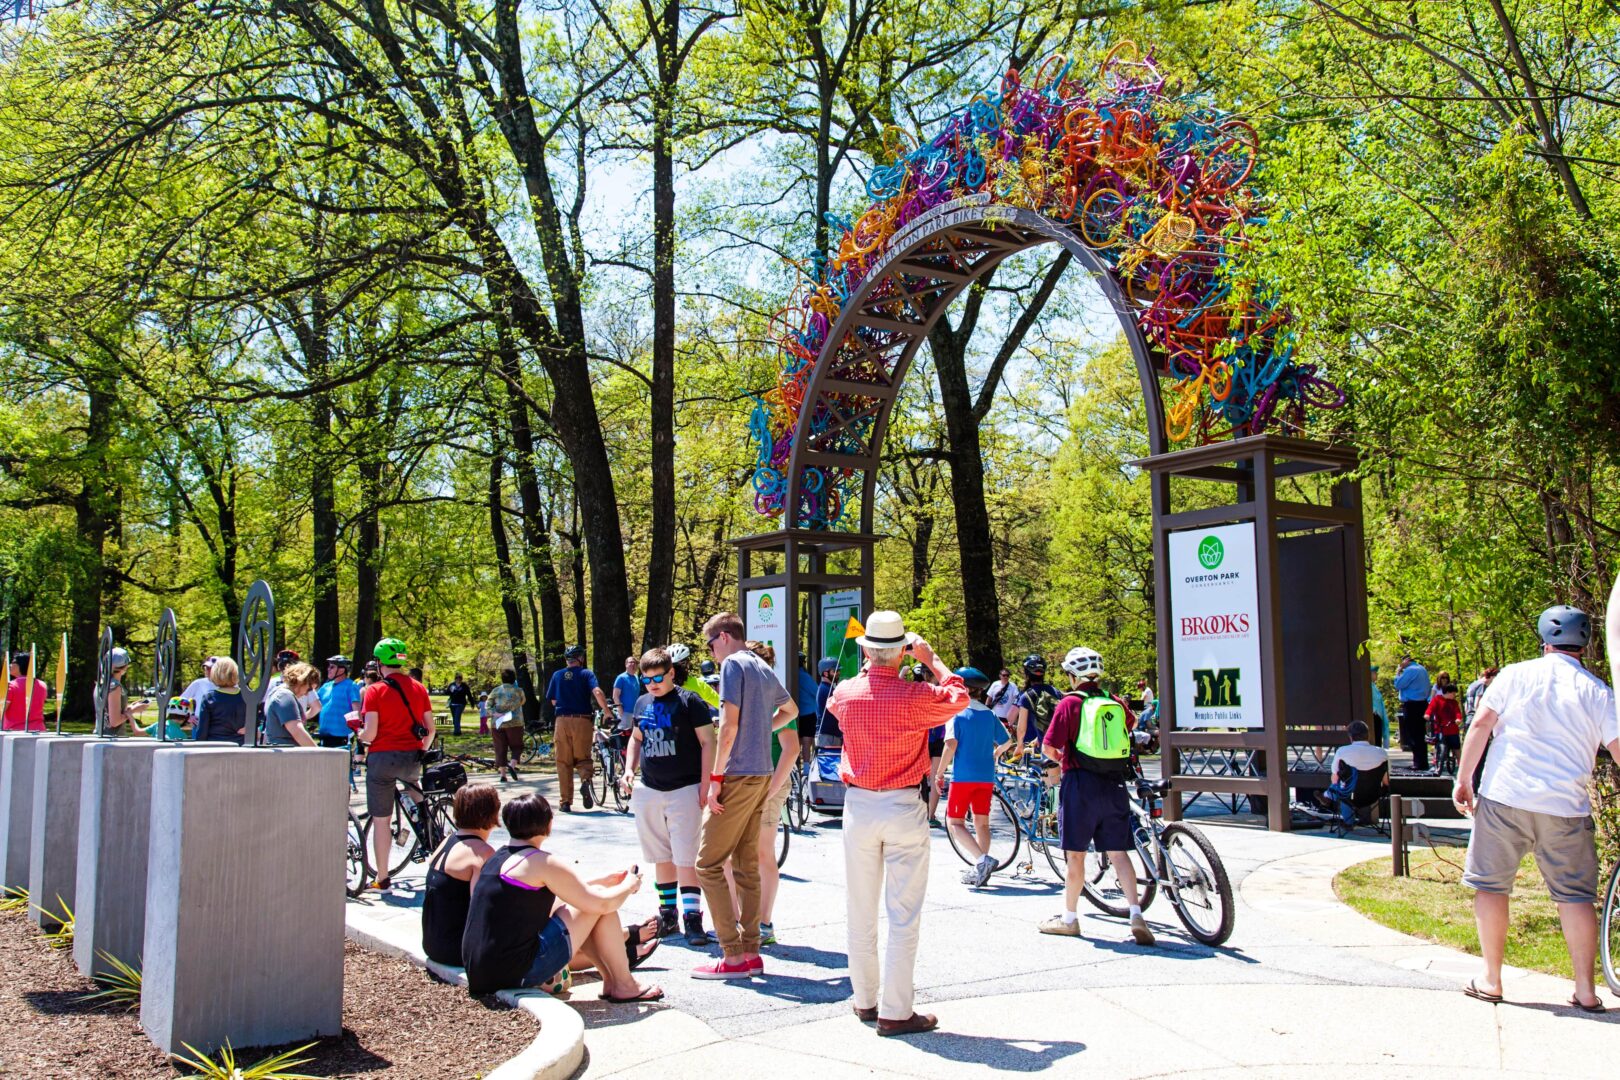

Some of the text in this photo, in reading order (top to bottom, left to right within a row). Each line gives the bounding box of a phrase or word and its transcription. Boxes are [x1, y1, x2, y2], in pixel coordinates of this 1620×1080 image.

[870, 229, 920, 278] OVERTON
[923, 215, 950, 236] PARK
[953, 208, 977, 224] BIKE
[1185, 572, 1240, 584] OVERTON PARK
[1180, 613, 1250, 636] BROOKS
[1194, 711, 1214, 720] Memphis
[1229, 711, 1242, 720] Links
[644, 727, 665, 742] NO
[644, 740, 677, 758] GAIN
